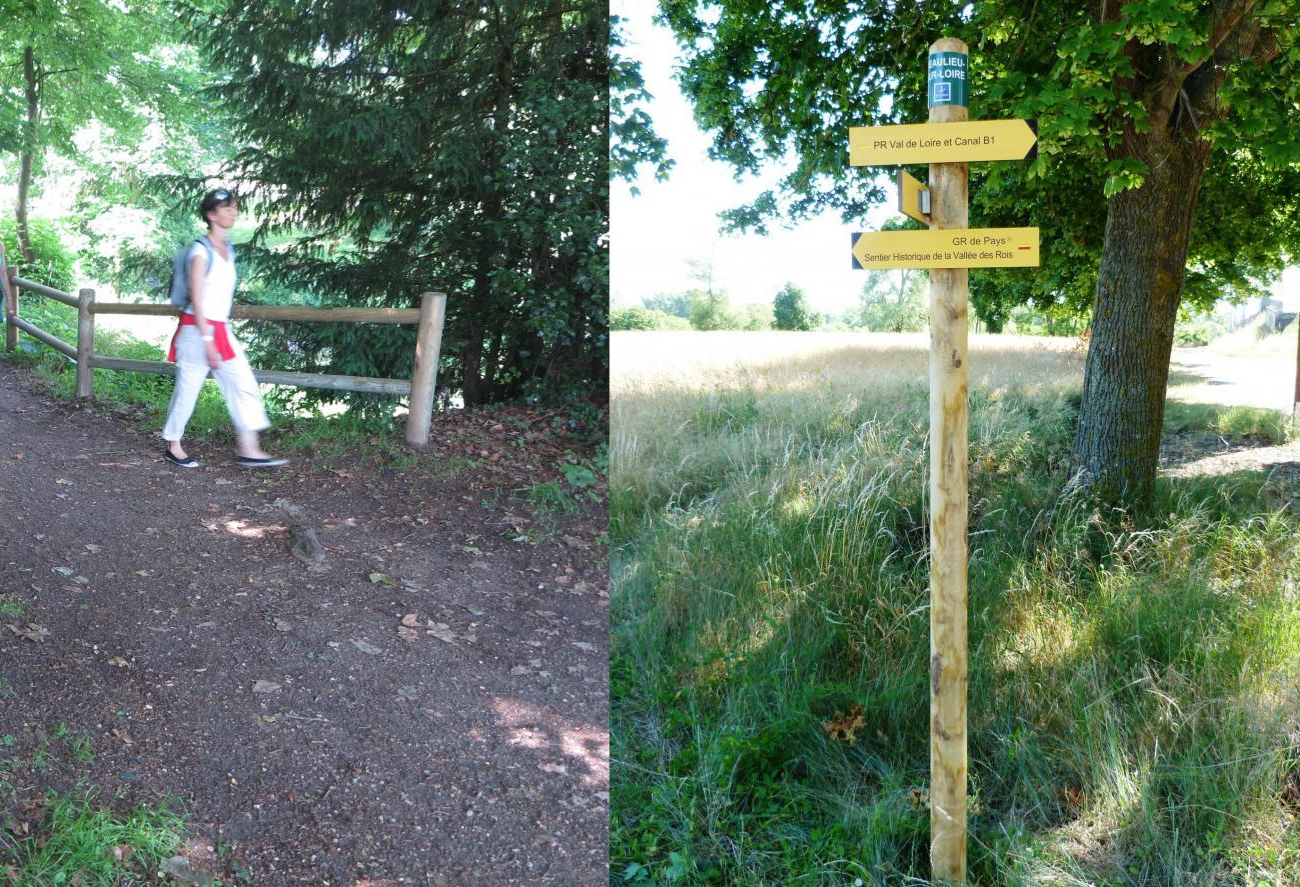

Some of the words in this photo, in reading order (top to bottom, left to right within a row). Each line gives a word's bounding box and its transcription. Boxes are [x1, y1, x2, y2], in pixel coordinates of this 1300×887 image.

[874, 141, 887, 149] PR
[890, 140, 904, 149] Val
[906, 139, 917, 148] de
[919, 138, 941, 148] Loire
[944, 138, 952, 146] et
[955, 136, 981, 146] Canal
[983, 136, 995, 145] B1
[952, 237, 967, 246] GR
[970, 237, 981, 245] de
[864, 253, 891, 262] Sentier
[893, 252, 931, 262] Historique
[932, 252, 942, 260] de
[944, 251, 952, 260] la
[953, 251, 978, 260] Vallée
[979, 251, 994, 259] des
[995, 250, 1013, 259] Rois
